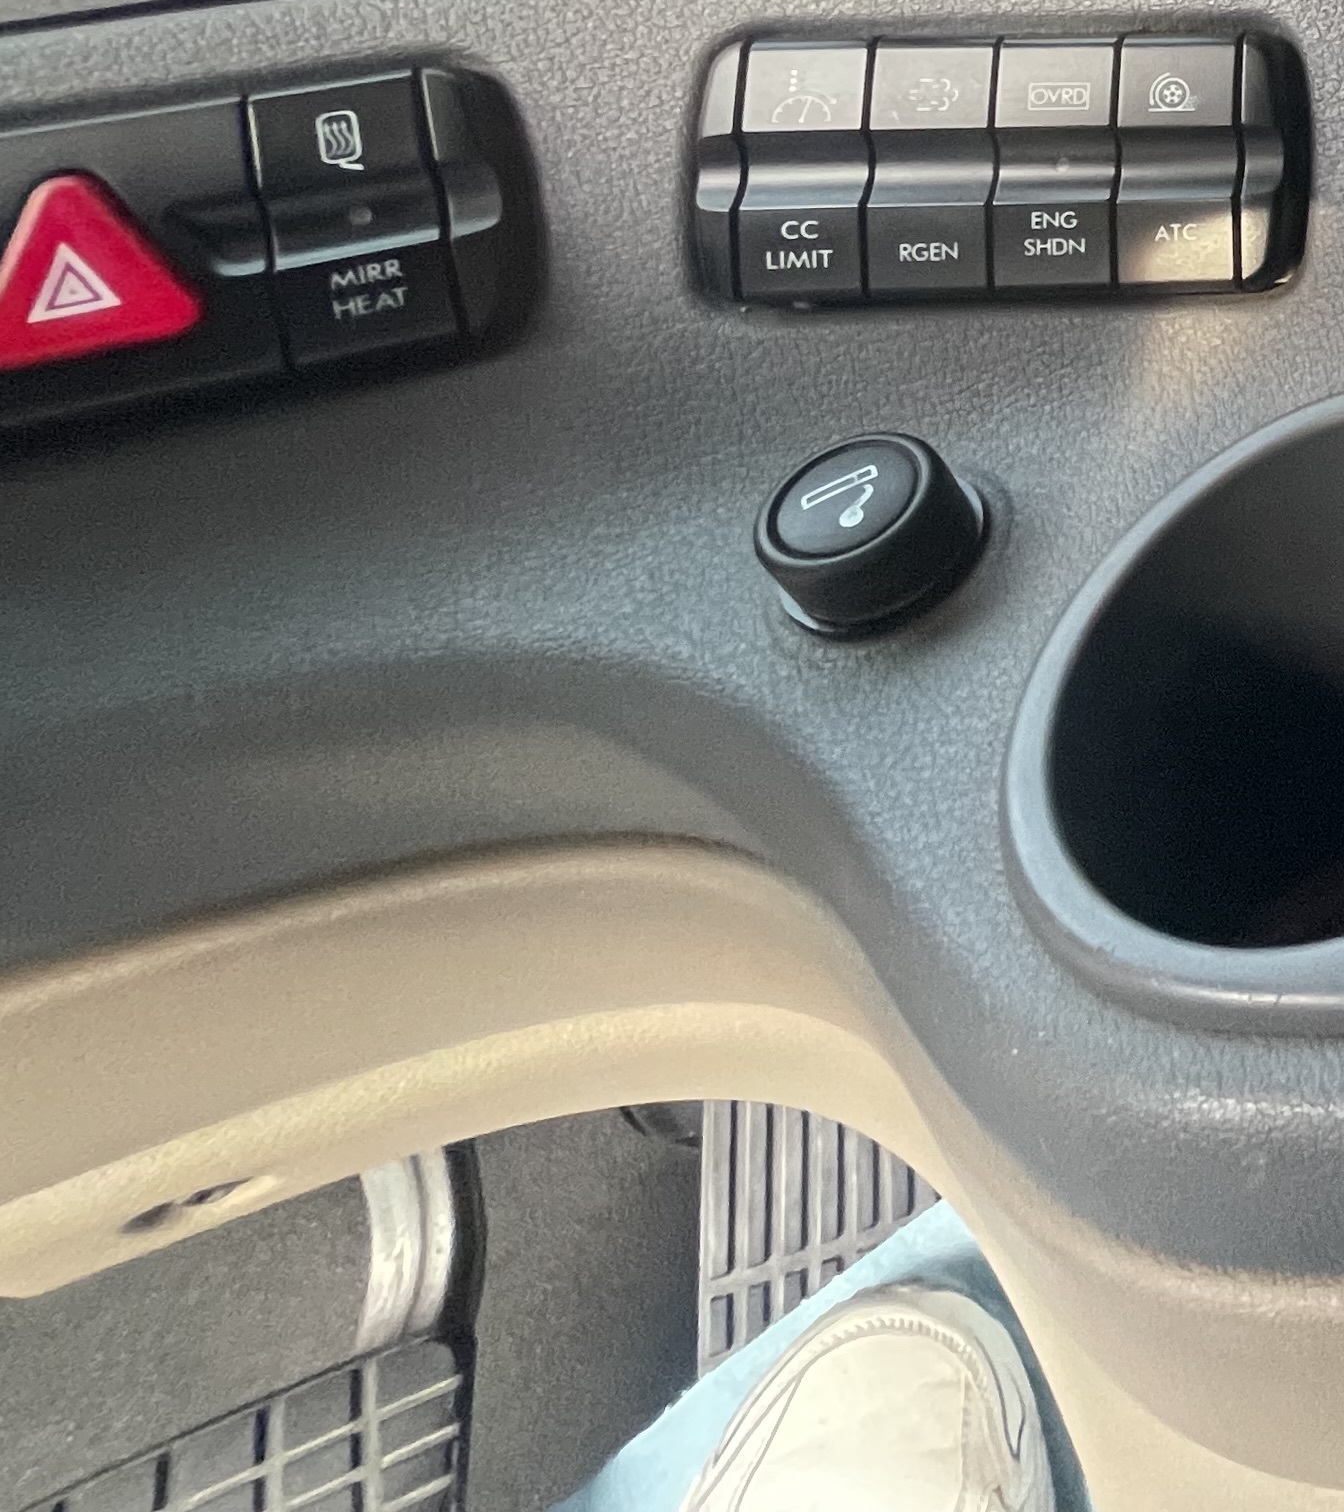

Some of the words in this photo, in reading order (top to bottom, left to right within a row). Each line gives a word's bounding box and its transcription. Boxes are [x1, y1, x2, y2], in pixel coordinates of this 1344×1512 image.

[1031, 87, 1087, 105] OVRD
[1031, 210, 1078, 229] ENG
[780, 220, 820, 240] CC
[1154, 223, 1198, 242] ATC
[898, 241, 959, 262] RGEN
[1023, 237, 1086, 256] SHDN
[765, 249, 834, 270] LIMIT
[330, 259, 403, 290] MIRR
[332, 287, 408, 320] HEAT
